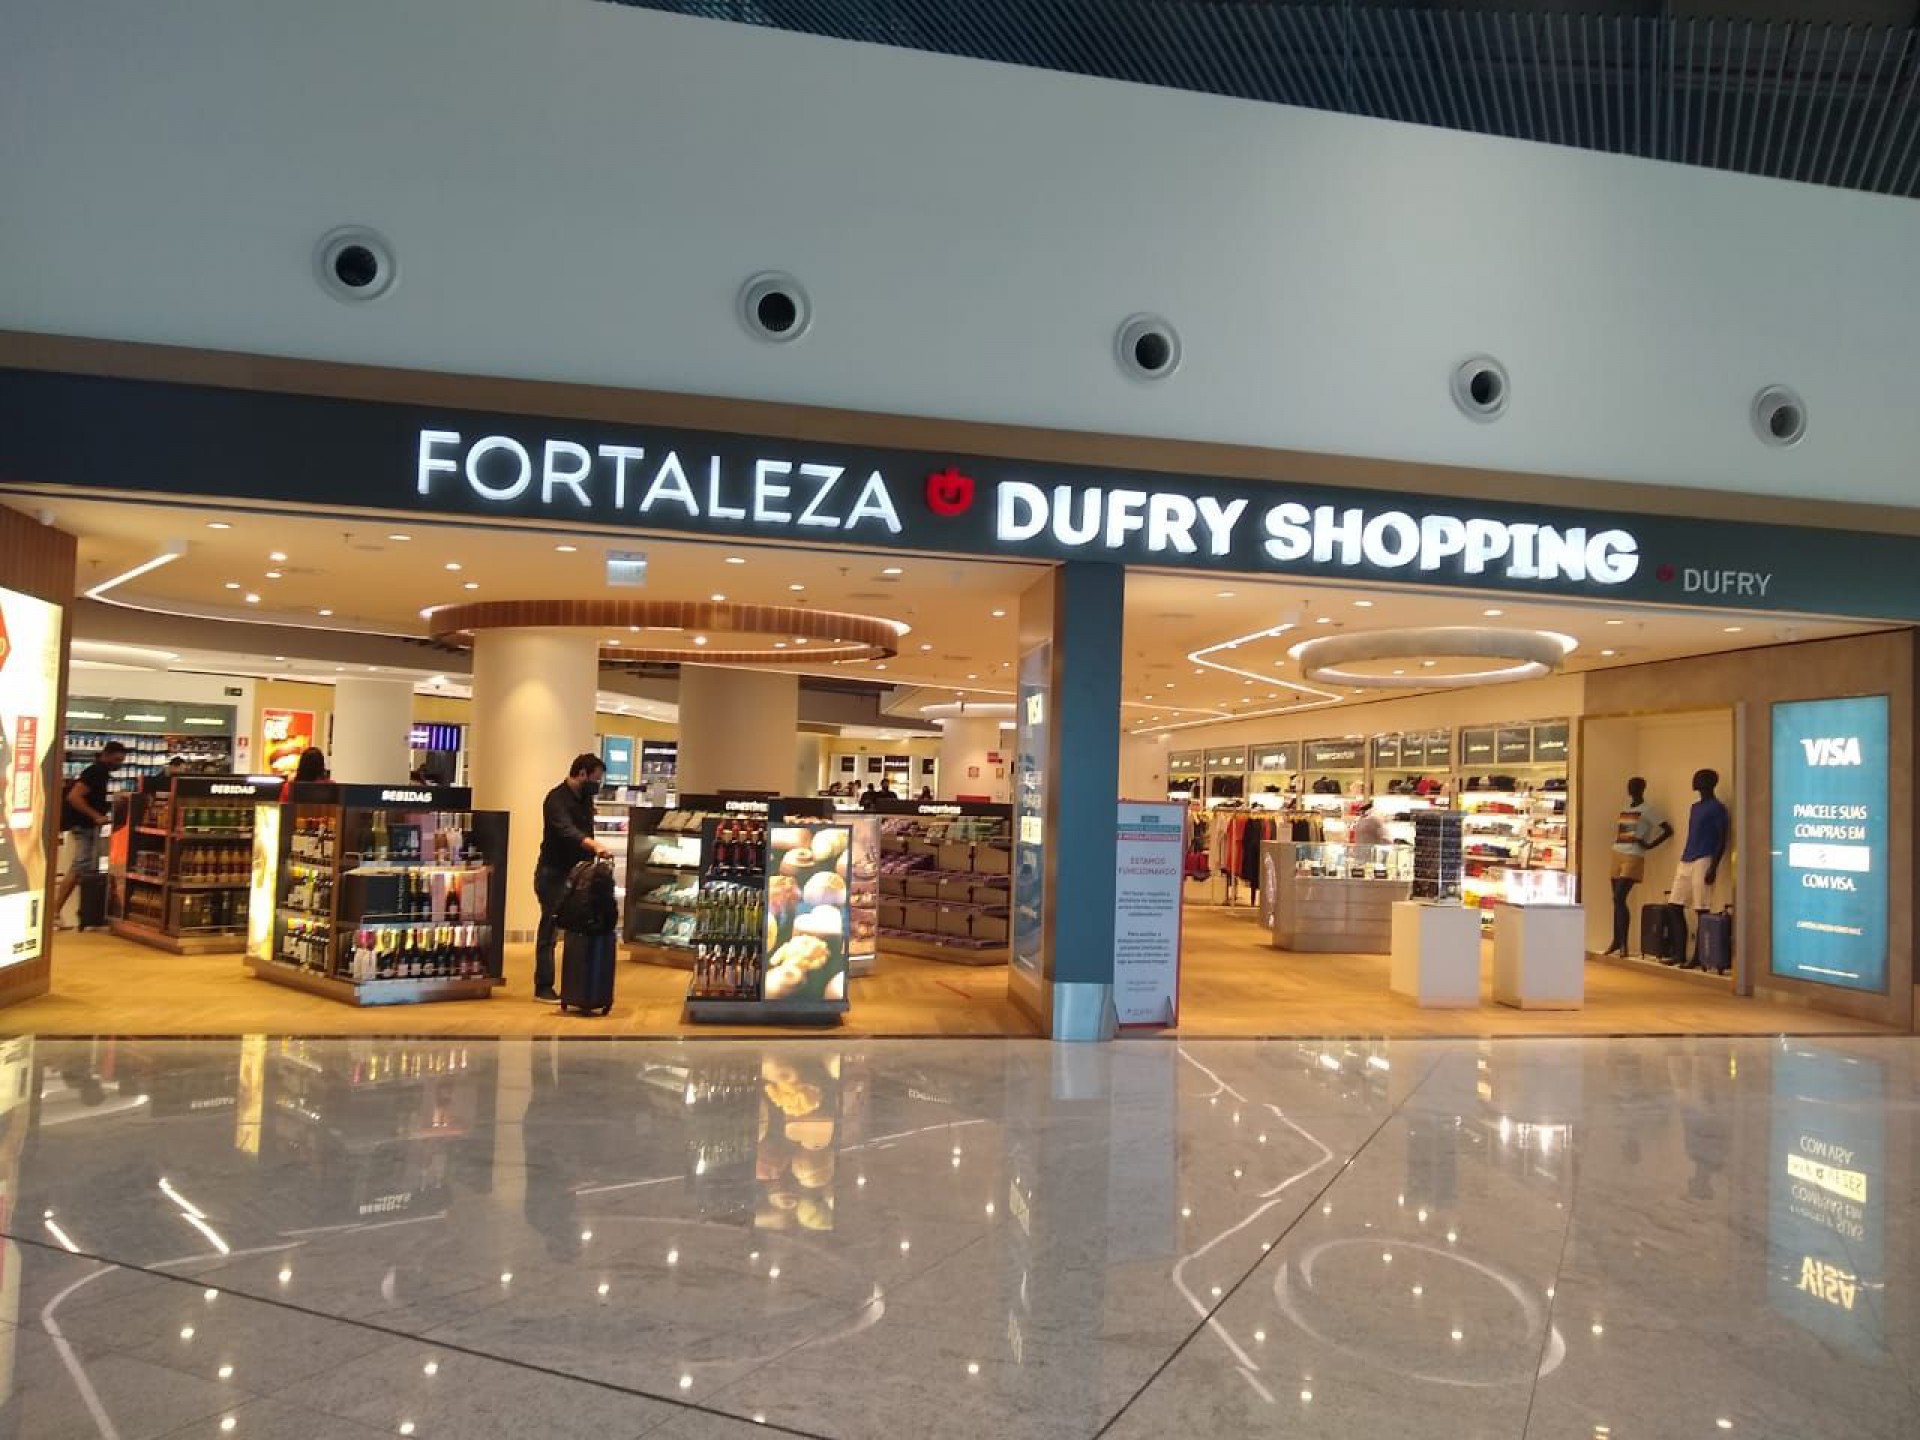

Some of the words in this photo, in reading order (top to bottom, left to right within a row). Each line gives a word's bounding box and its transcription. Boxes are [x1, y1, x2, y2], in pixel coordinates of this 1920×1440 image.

[417, 429, 902, 534] FORTALEZA
[997, 480, 1248, 556] DUFRY
[1264, 501, 1639, 584] SHOPPING
[1683, 568, 1773, 597] DUFRY
[1800, 737, 1861, 766] VISA
[210, 784, 256, 795] BEBIDAS
[381, 790, 433, 803] BEBIDAS
[1793, 804, 1836, 819] PARCELE
[1838, 805, 1867, 820] SUAS
[1795, 824, 1844, 840] COMPRAS
[1847, 826, 1865, 841] EM
[1802, 874, 1829, 889] COM
